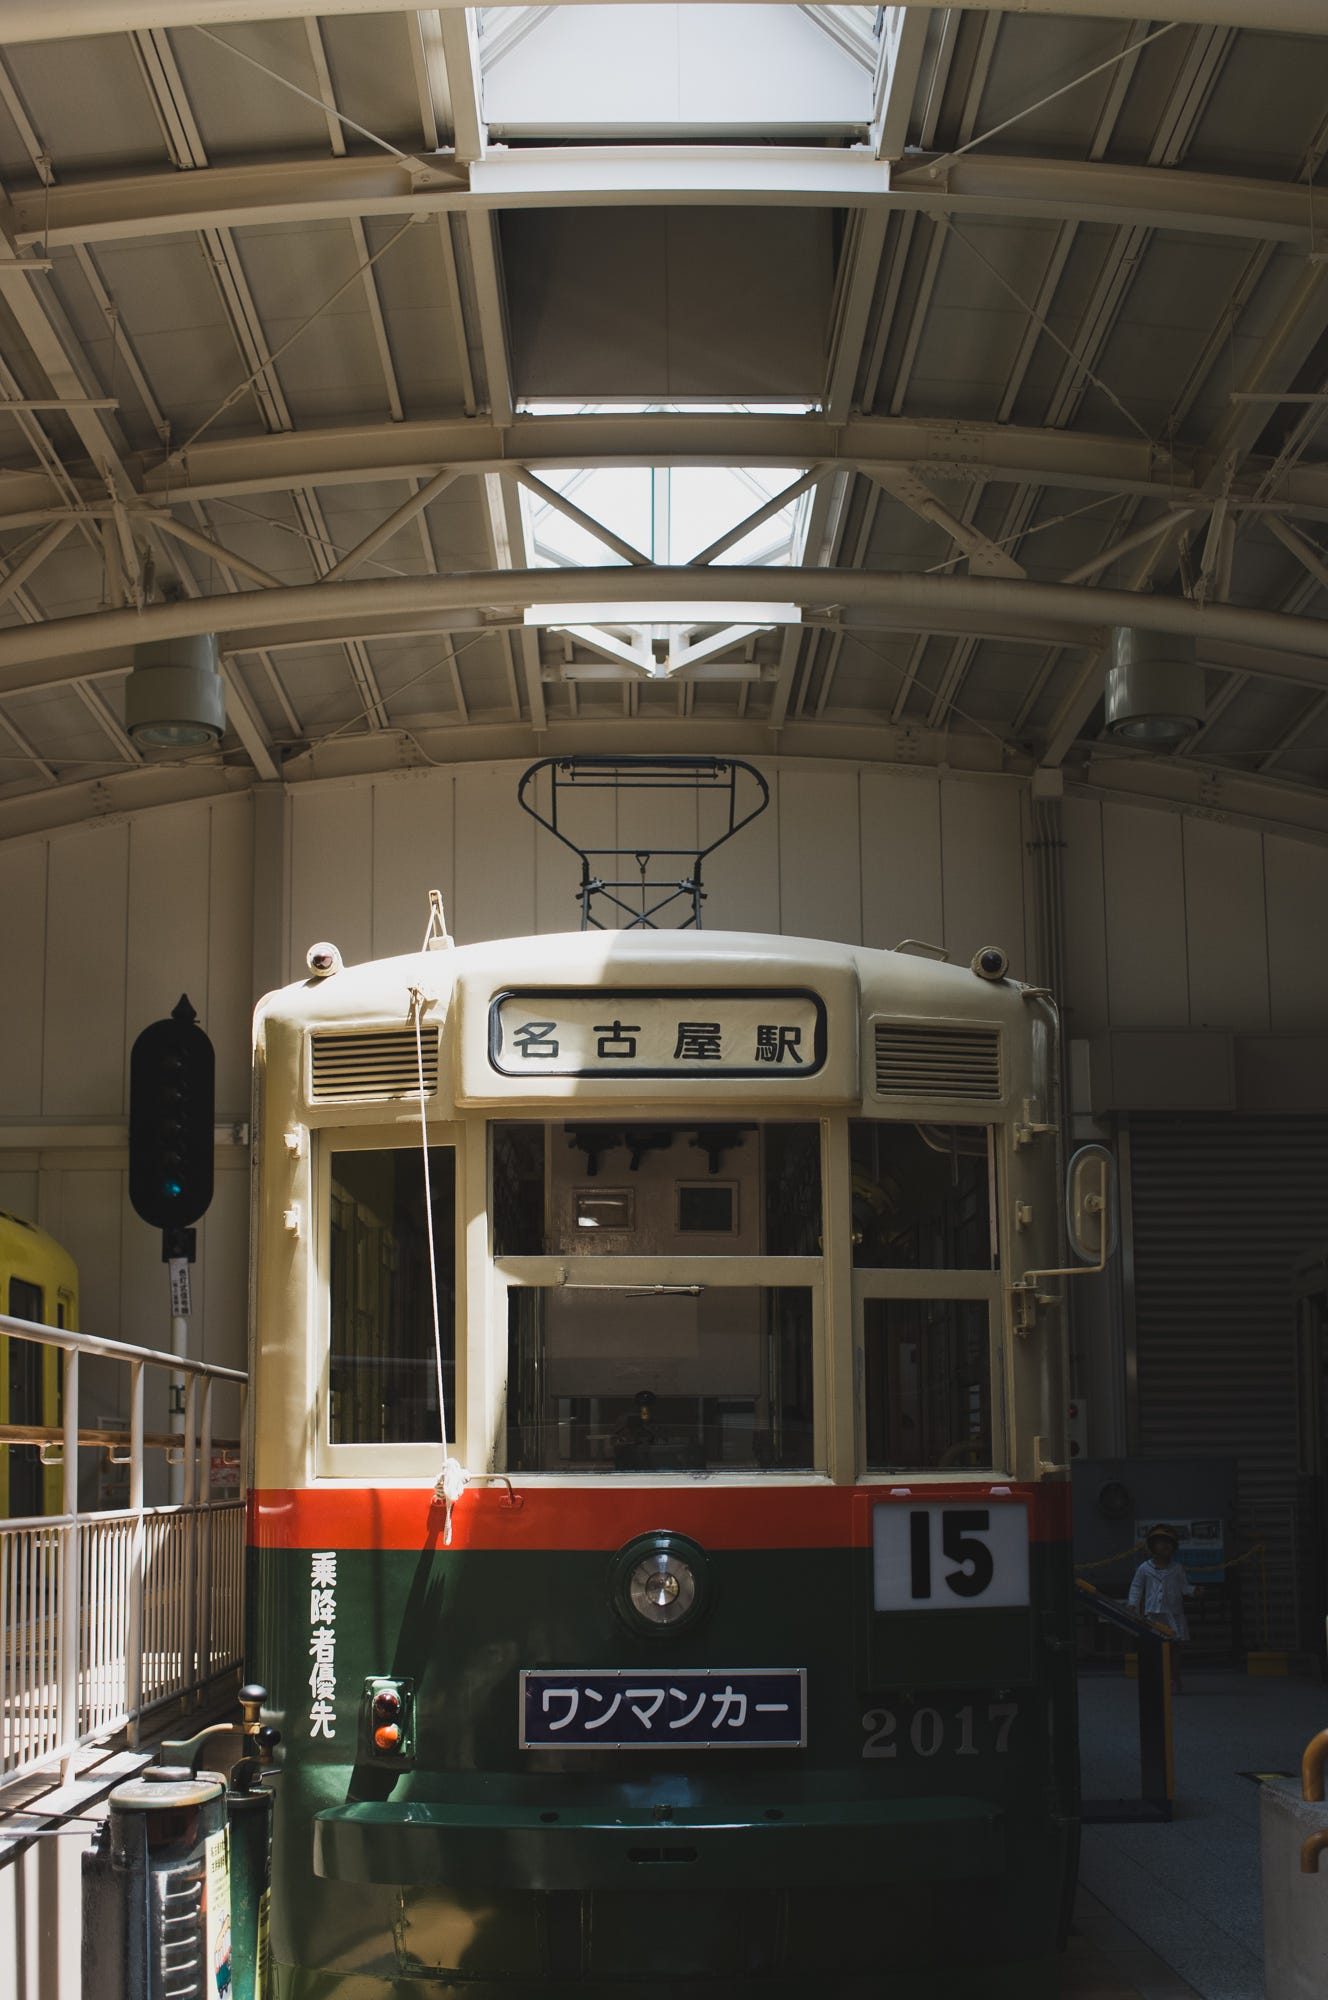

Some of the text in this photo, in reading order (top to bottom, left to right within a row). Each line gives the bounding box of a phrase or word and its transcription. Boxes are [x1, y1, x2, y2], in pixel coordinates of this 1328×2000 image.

[513, 1020, 803, 1064] 名古屋駅
[910, 1510, 993, 1599] 15
[309, 1552, 337, 1739] 乗降者優先
[542, 1685, 789, 1730] ワンマンカー
[861, 1703, 1018, 1758] 2017
